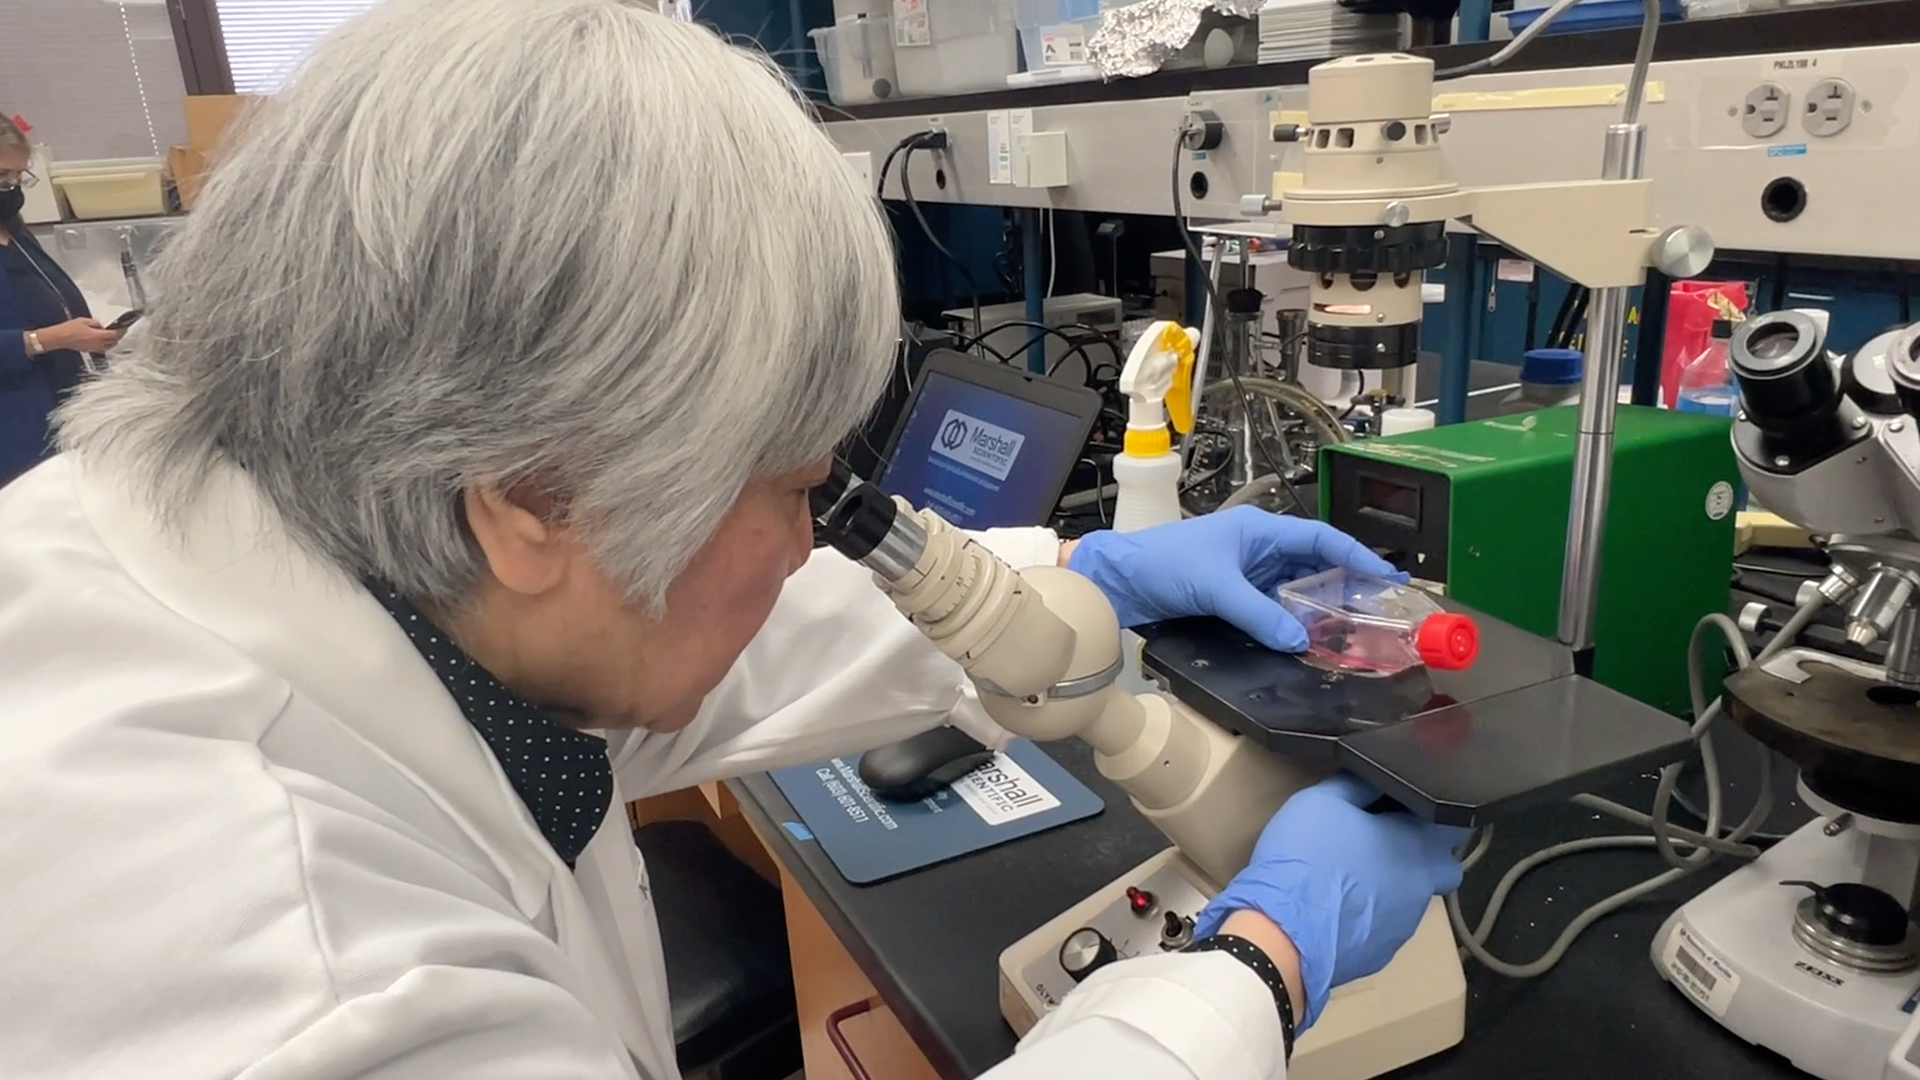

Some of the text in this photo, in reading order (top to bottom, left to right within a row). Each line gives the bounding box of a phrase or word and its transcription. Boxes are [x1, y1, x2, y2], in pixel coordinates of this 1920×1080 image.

[970, 426, 1017, 457] Marshall
[967, 770, 1014, 812] IENTIFIC
[976, 761, 1043, 808] arshall
